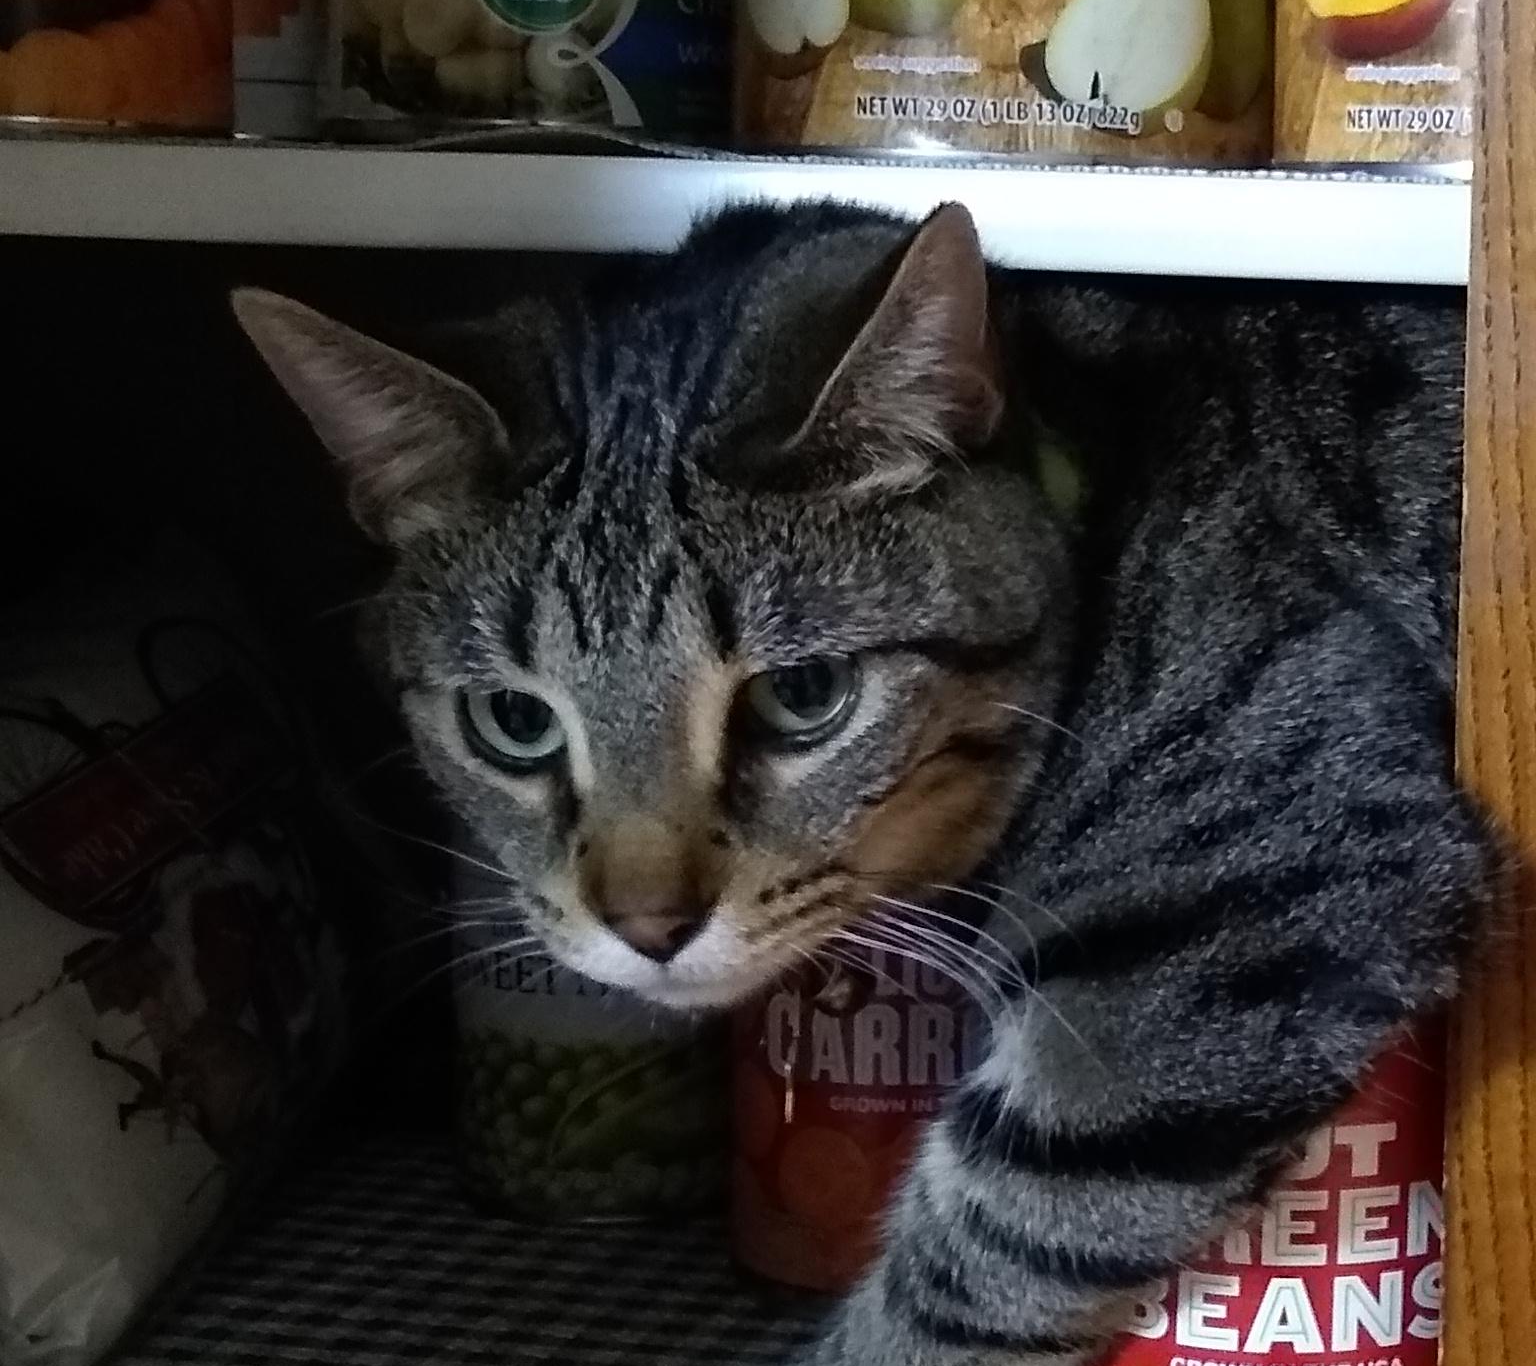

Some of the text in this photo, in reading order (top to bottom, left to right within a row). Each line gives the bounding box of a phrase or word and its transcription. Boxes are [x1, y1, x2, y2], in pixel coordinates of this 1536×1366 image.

[856, 96, 1140, 131] NET WT 29 OZ (1 LB 13 OZ) 822g
[1346, 108, 1455, 131] NET WT 29 OZ
[829, 1095, 906, 1113] GROWN
[1286, 1122, 1397, 1181] UT
[1205, 1180, 1444, 1267] EEN
